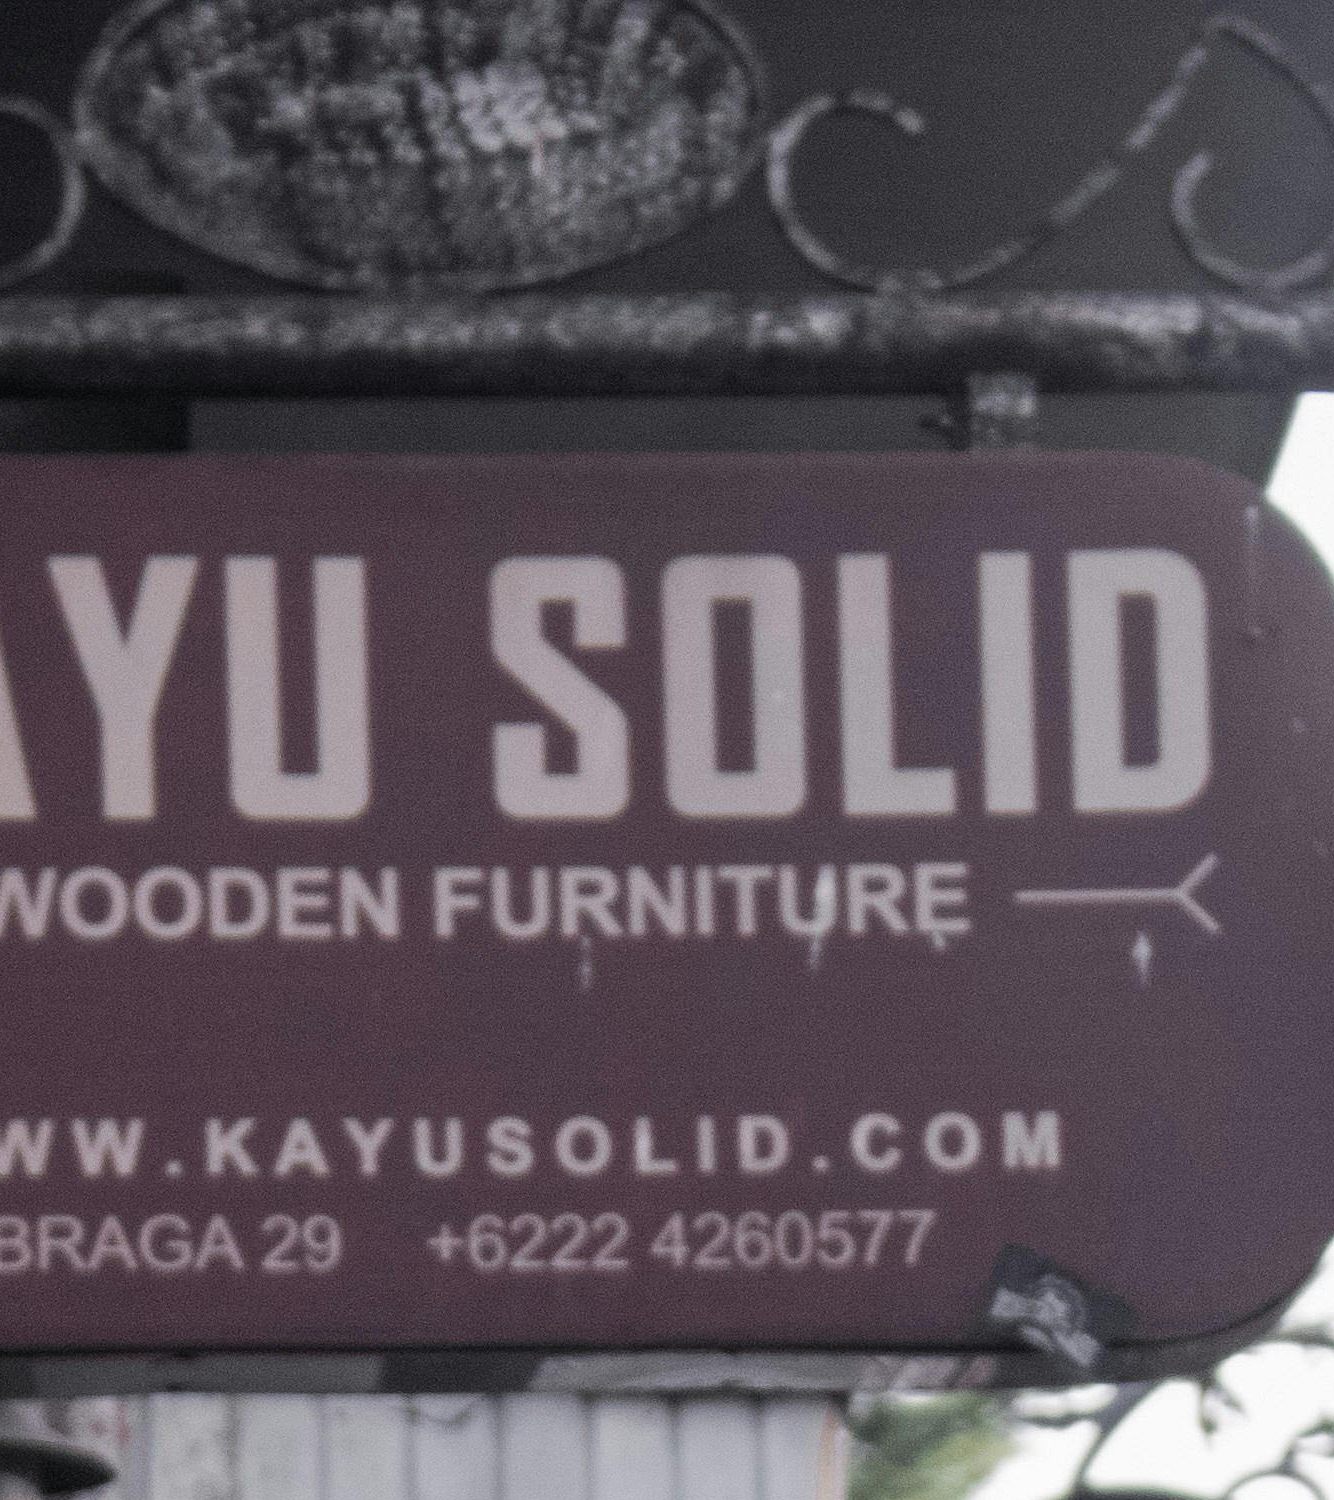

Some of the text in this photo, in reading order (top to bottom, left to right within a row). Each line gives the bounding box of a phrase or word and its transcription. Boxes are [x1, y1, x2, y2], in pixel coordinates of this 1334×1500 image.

[491, 548, 1213, 820] SOLID
[434, 863, 970, 937] FURNITURE
[260, 1211, 344, 1274] 29
[426, 1210, 631, 1274] +6222
[649, 1207, 938, 1271] 4260577
